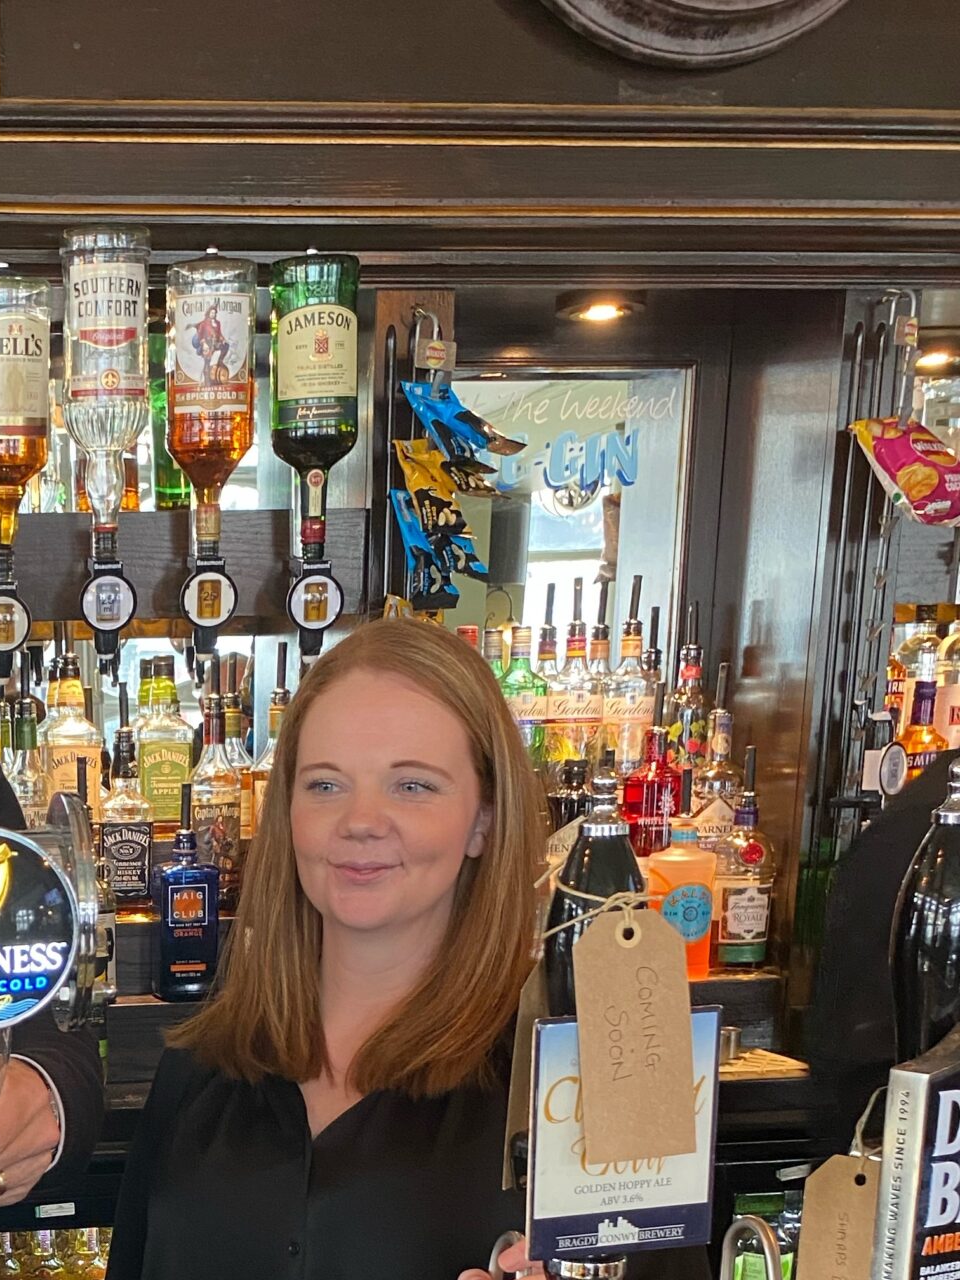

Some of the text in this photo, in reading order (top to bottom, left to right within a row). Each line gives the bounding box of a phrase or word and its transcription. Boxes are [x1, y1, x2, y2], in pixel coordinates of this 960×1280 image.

[73, 278, 141, 299] SOUTHERN
[78, 300, 137, 317] COMFORT
[286, 311, 352, 336] JAMESON
[186, 391, 237, 401] SPICED GOLD
[503, 387, 676, 425] The Weekend
[143, 748, 190, 768] JACK DANIEL'S
[194, 806, 219, 820] Captain
[103, 828, 150, 847] JACK DANIEL'S
[173, 891, 203, 901] HAIG
[172, 910, 204, 919] CLUB
[734, 913, 763, 922] ROYALE
[635, 965, 664, 1073] COMING
[603, 1004, 633, 1083] SOON
[899, 1090, 911, 1122] 1994
[894, 1129, 907, 1171] SINCE
[574, 1176, 673, 1196] GOLDEN HOPPY ALE
[600, 1196, 621, 1207] ABV
[888, 1175, 903, 1223] WAVES
[558, 1226, 685, 1249] BRAGDY CONWY BREWERY
[921, 1232, 960, 1257] AMBE
